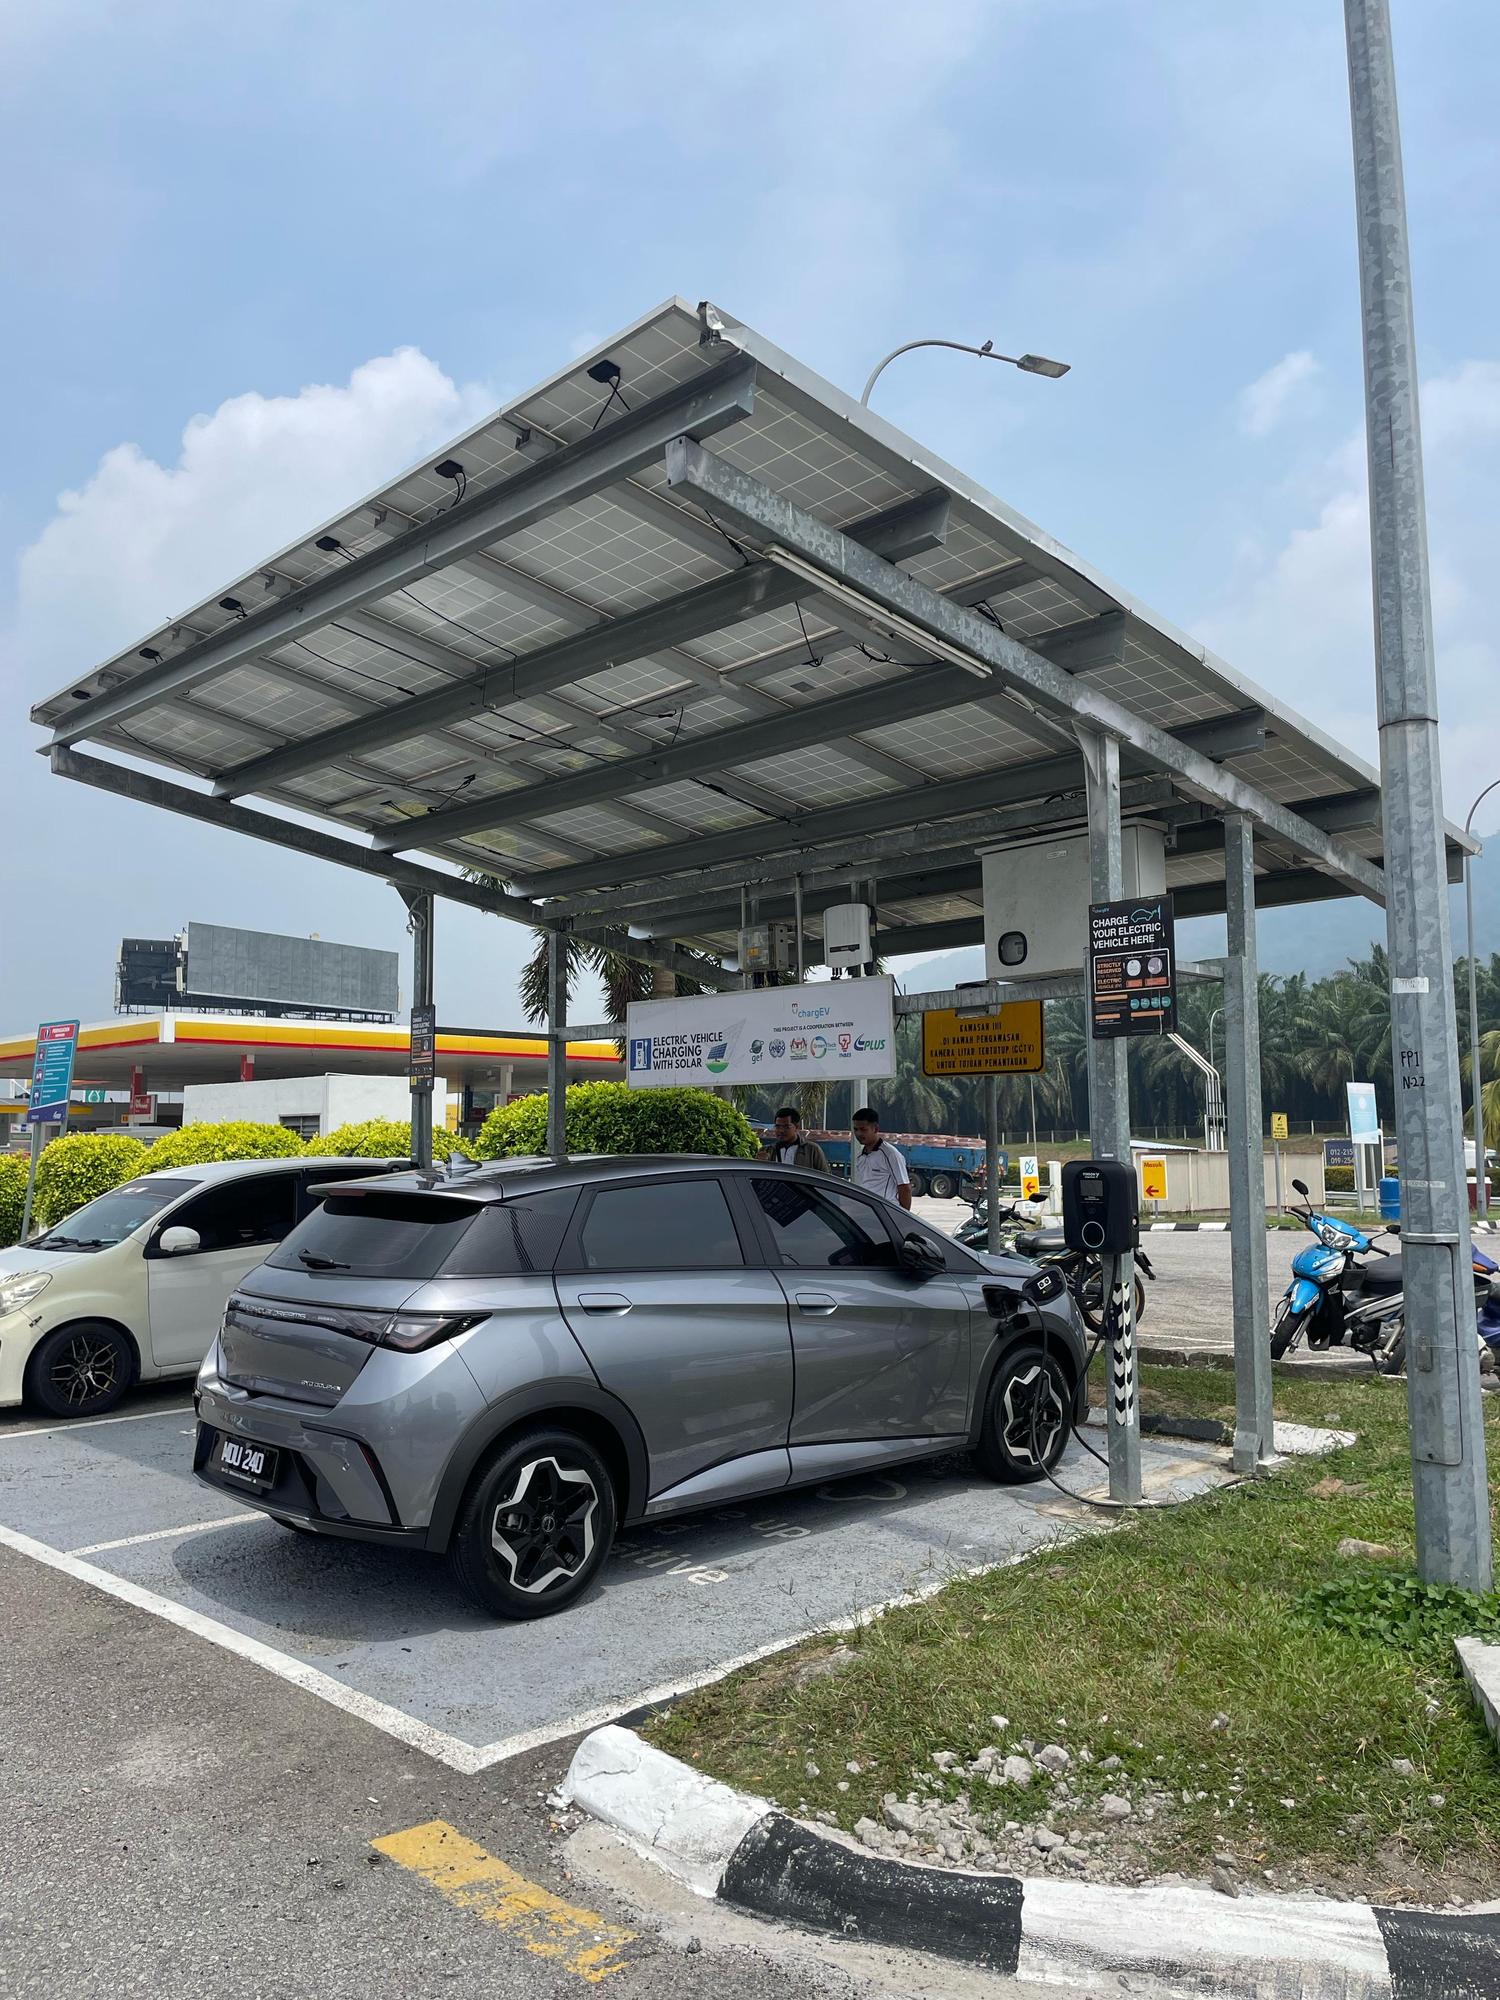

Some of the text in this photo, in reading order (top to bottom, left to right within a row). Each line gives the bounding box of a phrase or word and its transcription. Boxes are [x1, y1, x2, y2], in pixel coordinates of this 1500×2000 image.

[1092, 916, 1129, 928] CHARGE
[1093, 922, 1161, 939] YOUR ELECTRIC
[1093, 934, 1155, 949] VEHICLE HERE
[653, 1031, 723, 1047] ELECTRIC VEHICLE
[864, 1039, 886, 1051] PLUS
[652, 1045, 702, 1059] CHARGING
[1011, 1044, 1035, 1054] (CCTV)
[653, 1057, 702, 1070] WITH SOLAR
[751, 1052, 763, 1065] gef
[241, 1449, 265, 1474] 240
